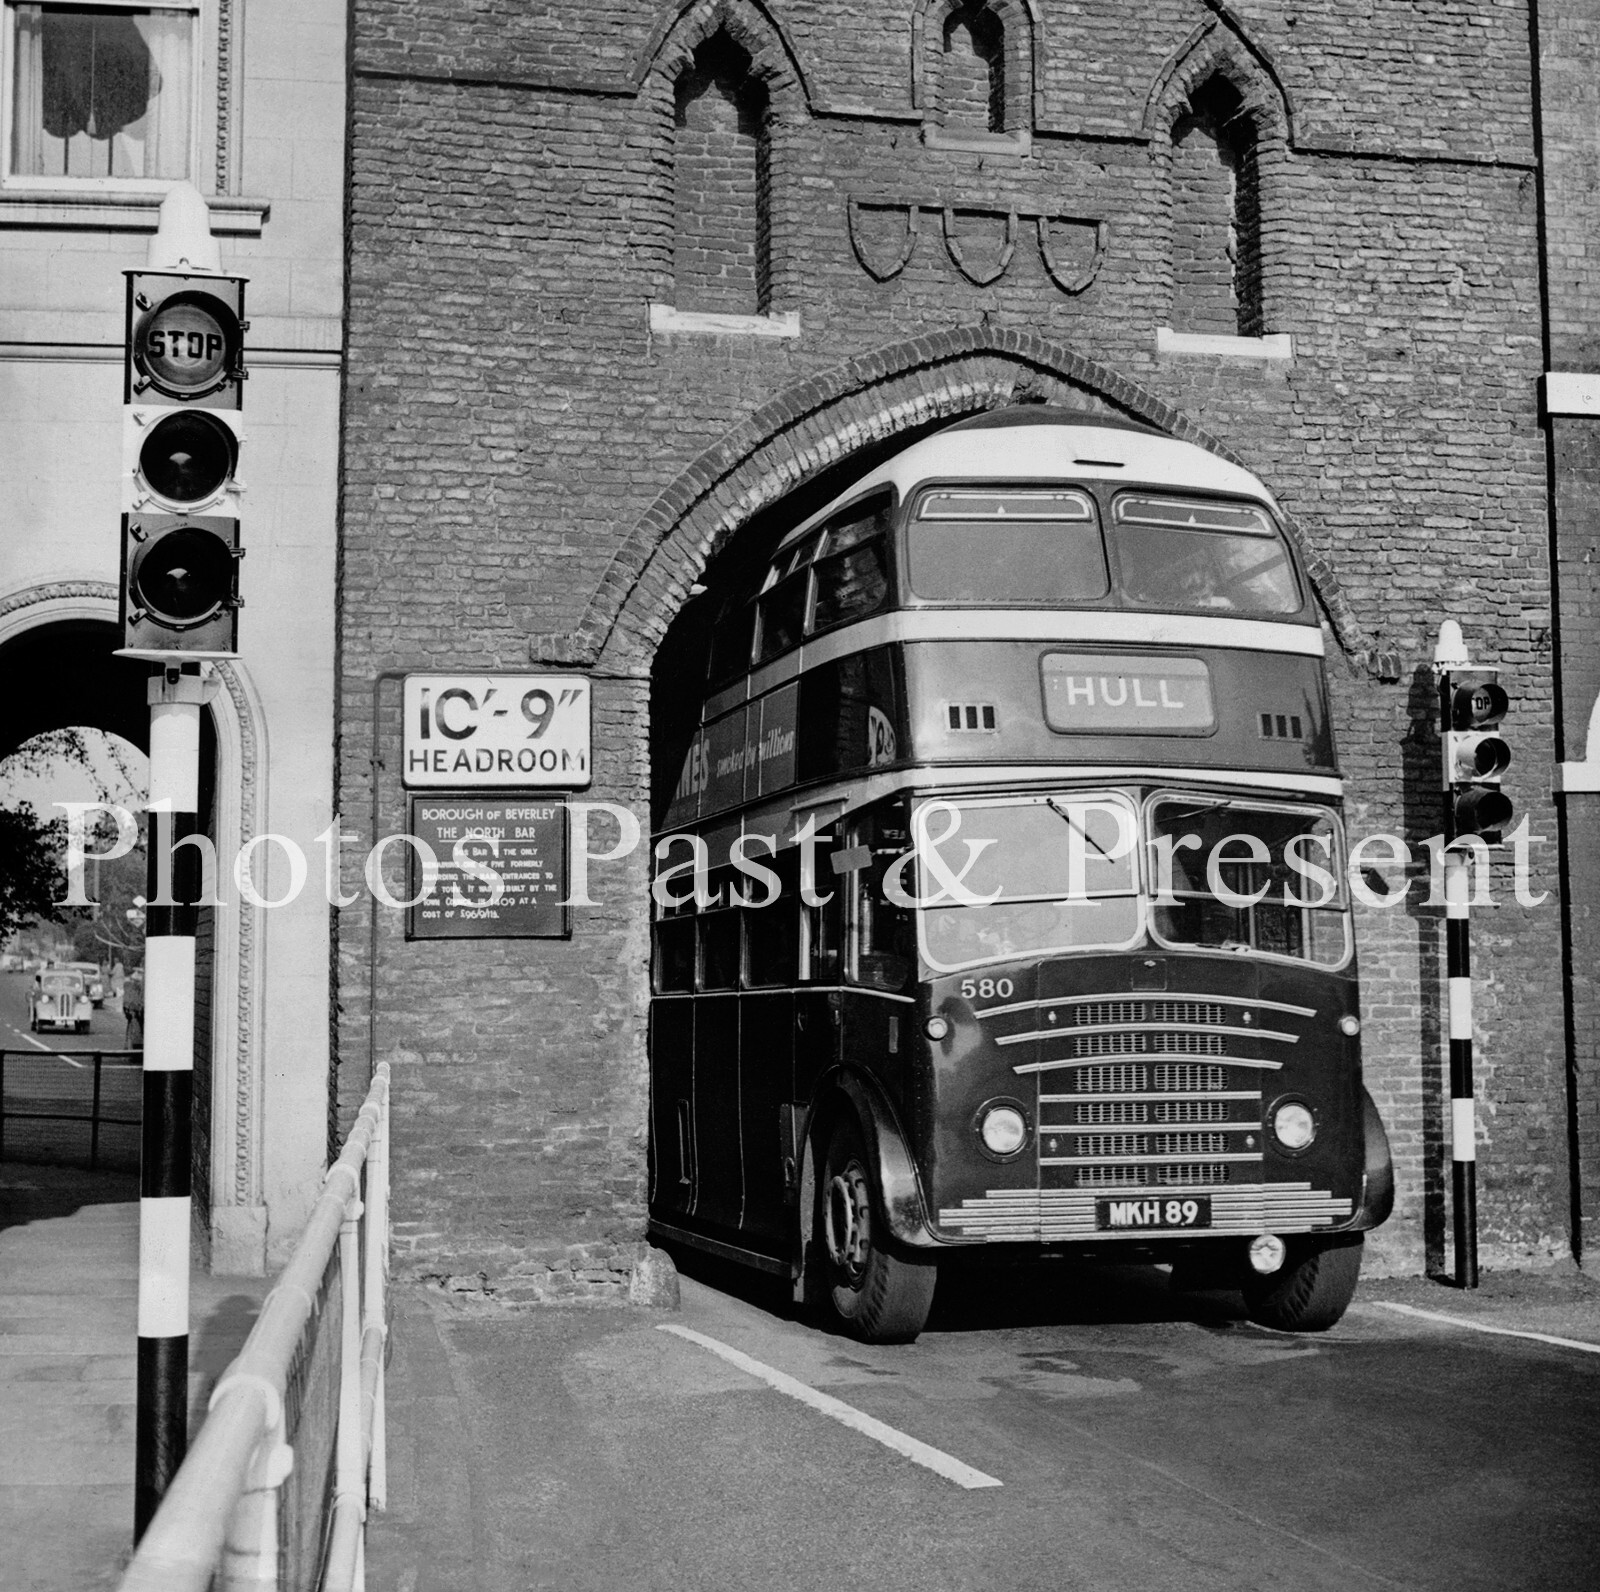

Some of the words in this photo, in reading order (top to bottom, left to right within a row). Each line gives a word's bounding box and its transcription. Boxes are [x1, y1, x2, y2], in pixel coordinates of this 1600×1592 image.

[149, 330, 222, 360] STOP
[1066, 676, 1184, 709] HULL
[408, 748, 586, 773] HEADROOM
[421, 808, 484, 820] BOROUGH
[505, 808, 556, 820] BEVERLEY
[437, 827, 457, 839] THE
[465, 827, 505, 839] NORTH
[515, 827, 536, 839] BAR
[422, 910, 440, 918] COST
[961, 979, 1014, 998] 580
[1109, 1201, 1161, 1225] MKH
[1165, 1200, 1198, 1226] 89
